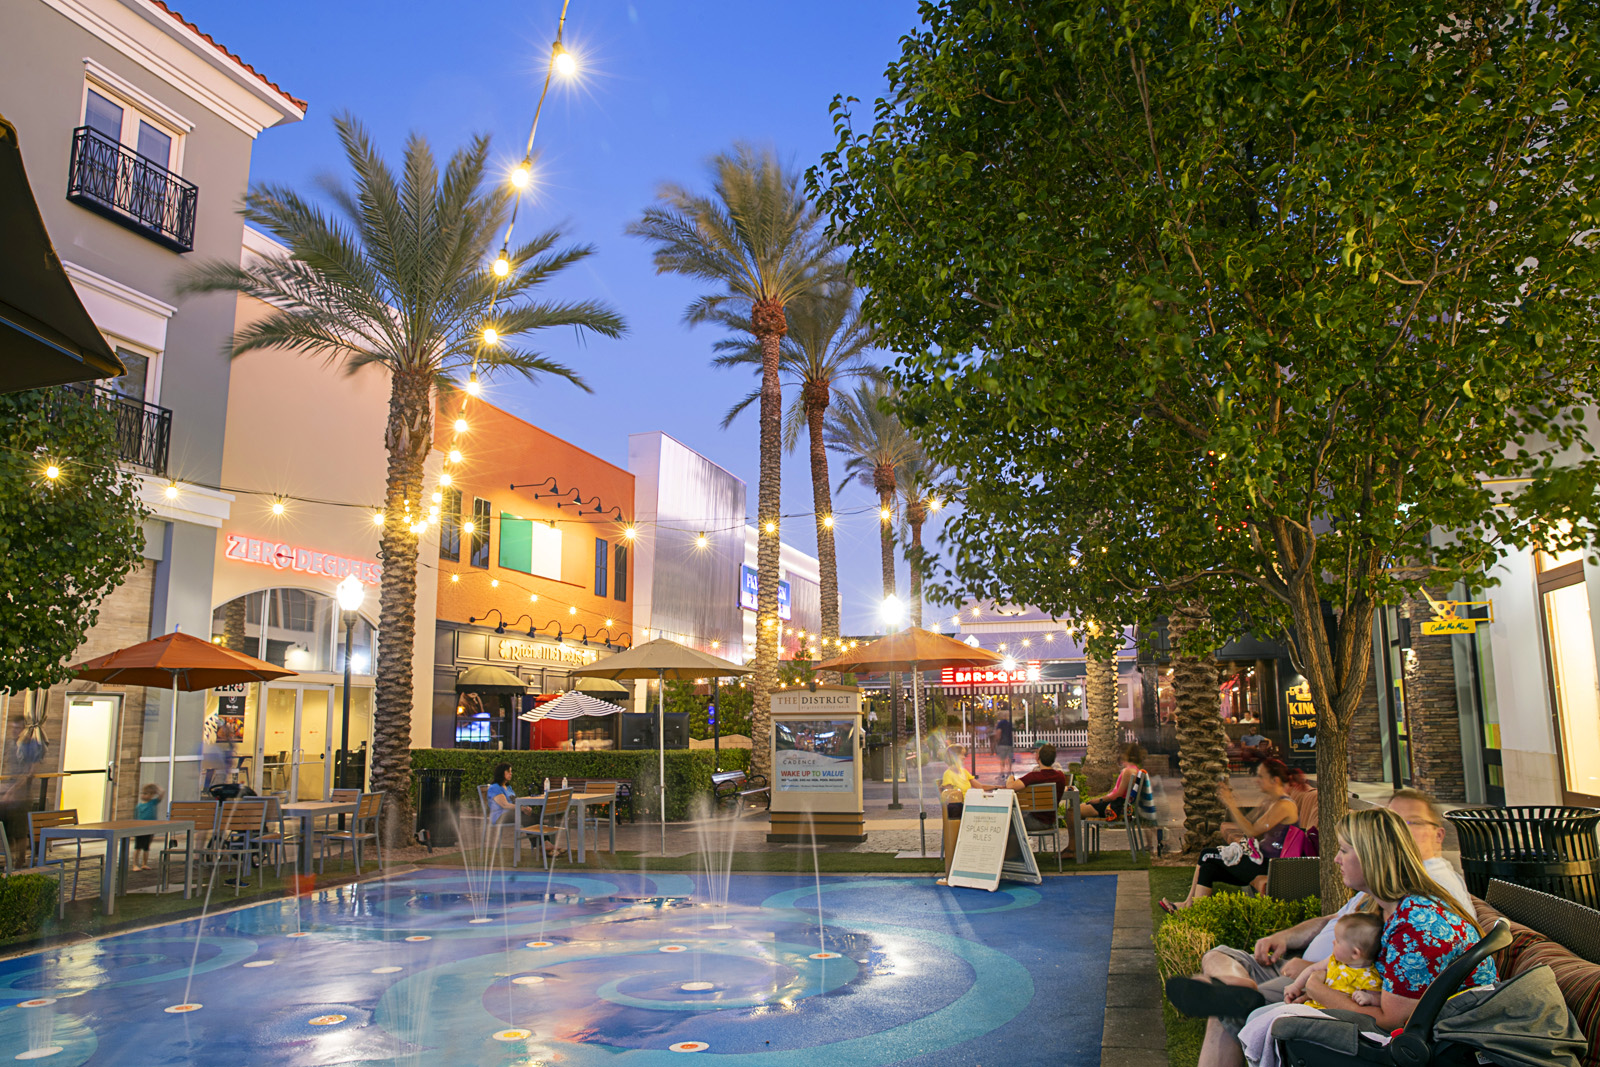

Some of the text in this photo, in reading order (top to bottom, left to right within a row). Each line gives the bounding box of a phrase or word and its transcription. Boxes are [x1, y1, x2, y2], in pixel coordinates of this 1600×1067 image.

[227, 536, 381, 585] ZERO DEGREES
[777, 695, 851, 705] THE DISTRICT
[1289, 702, 1316, 715] KING
[966, 824, 989, 833] SPLASH
